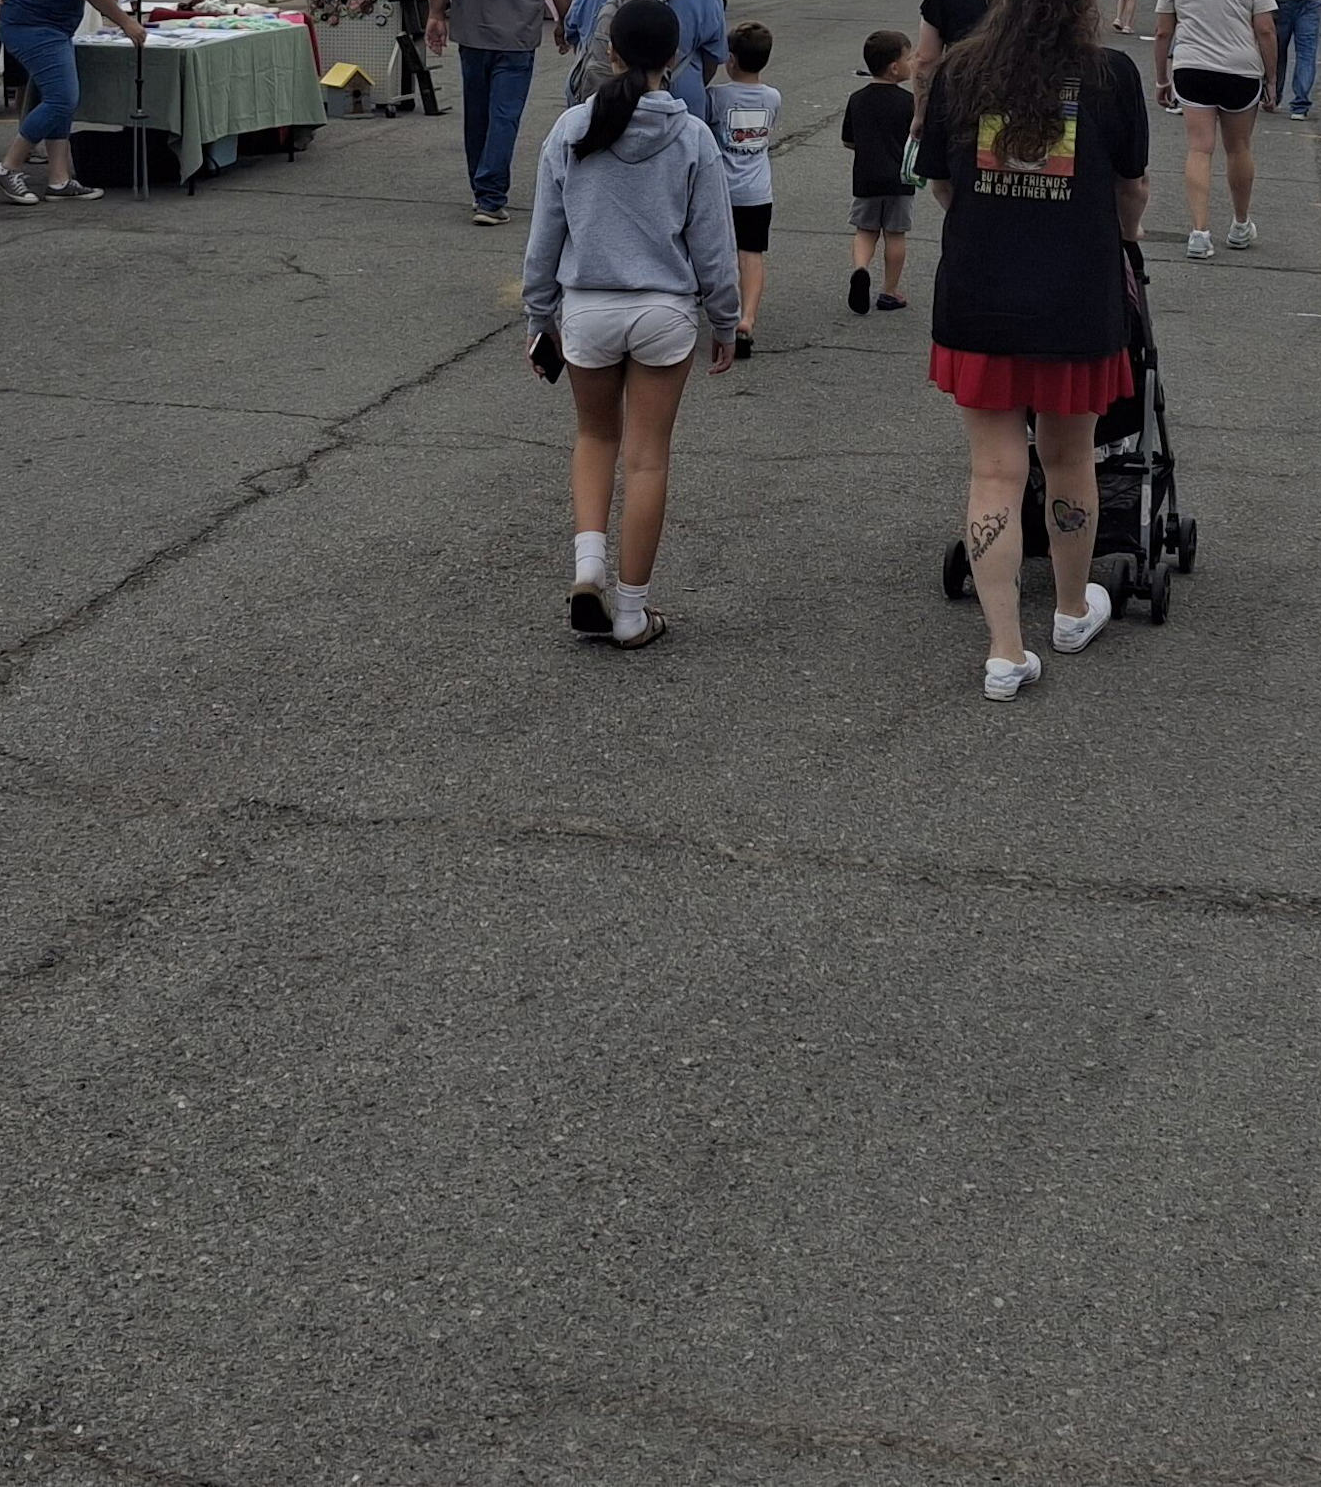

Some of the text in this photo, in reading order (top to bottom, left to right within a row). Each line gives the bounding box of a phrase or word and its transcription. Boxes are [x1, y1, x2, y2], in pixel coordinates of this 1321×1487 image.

[981, 170, 1068, 188] BUT MY FRIENDS
[974, 181, 1072, 201] CAN GO EITHER WAY
